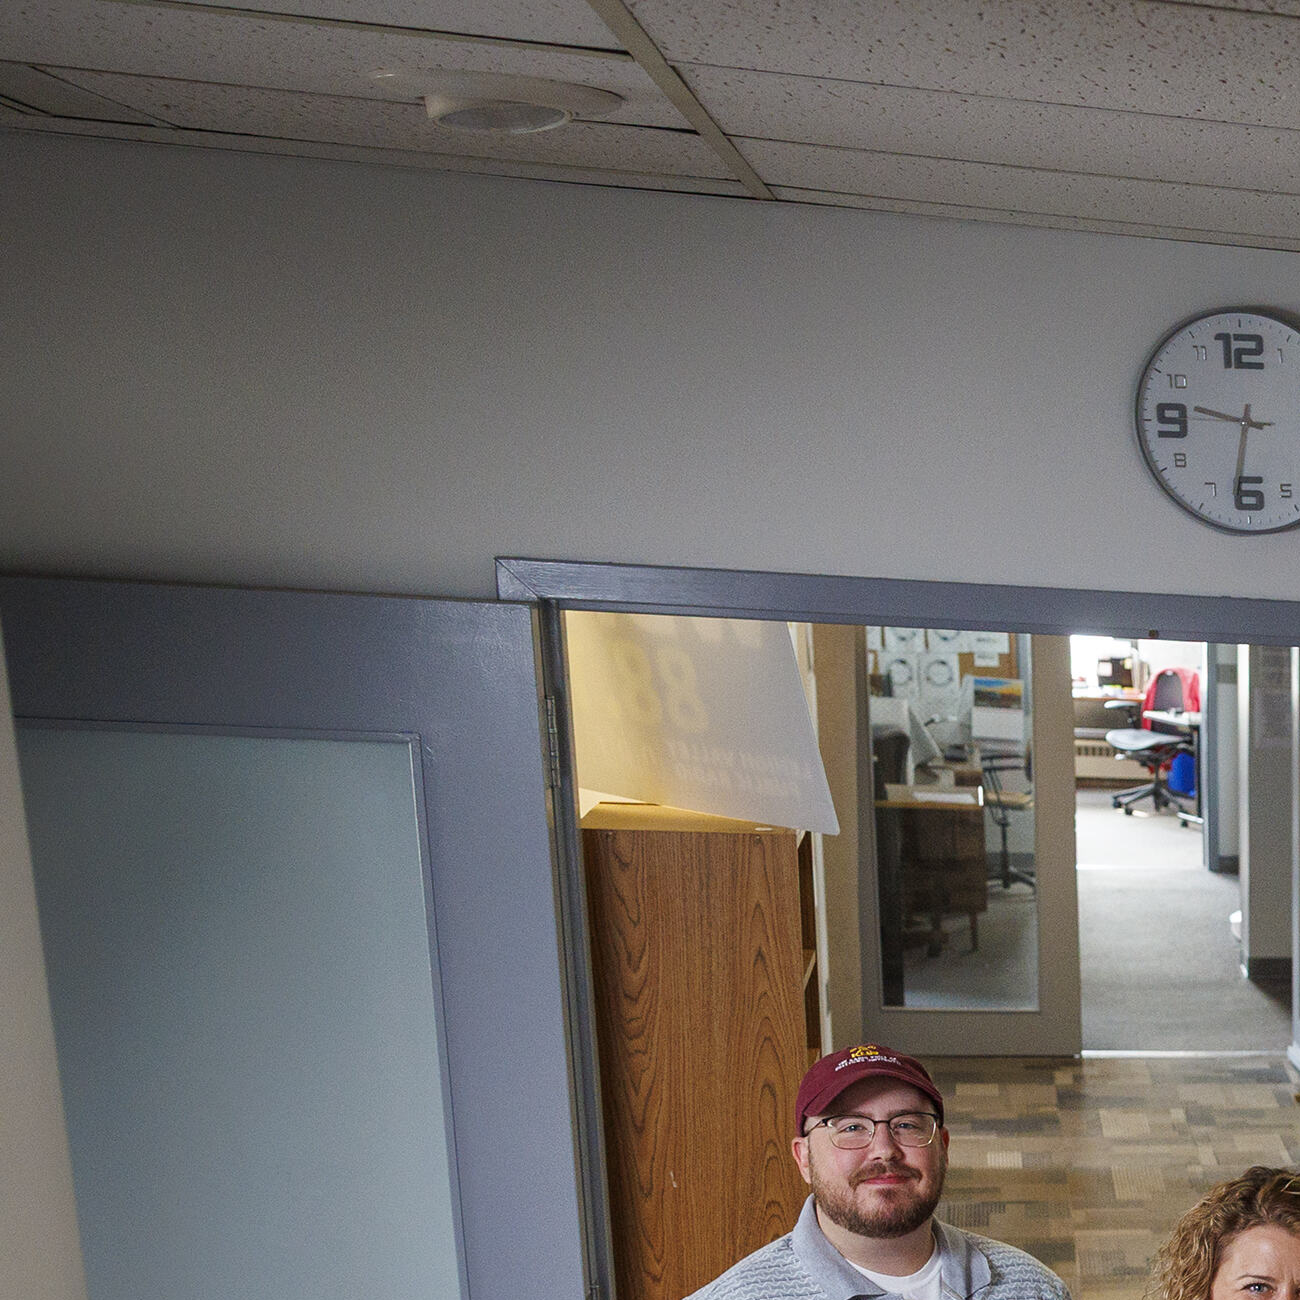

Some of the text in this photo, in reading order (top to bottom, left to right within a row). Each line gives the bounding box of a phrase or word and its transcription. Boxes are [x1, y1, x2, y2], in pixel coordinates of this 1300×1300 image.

[1193, 345, 1208, 361] 11
[1214, 333, 1265, 370] 12
[1277, 348, 1283, 364] 1
[1167, 374, 1187, 389] 10
[1156, 403, 1188, 439] 9
[1174, 453, 1187, 468] 8
[1205, 482, 1217, 497] 7
[1234, 476, 1265, 511] 6
[1280, 484, 1293, 498] 5
